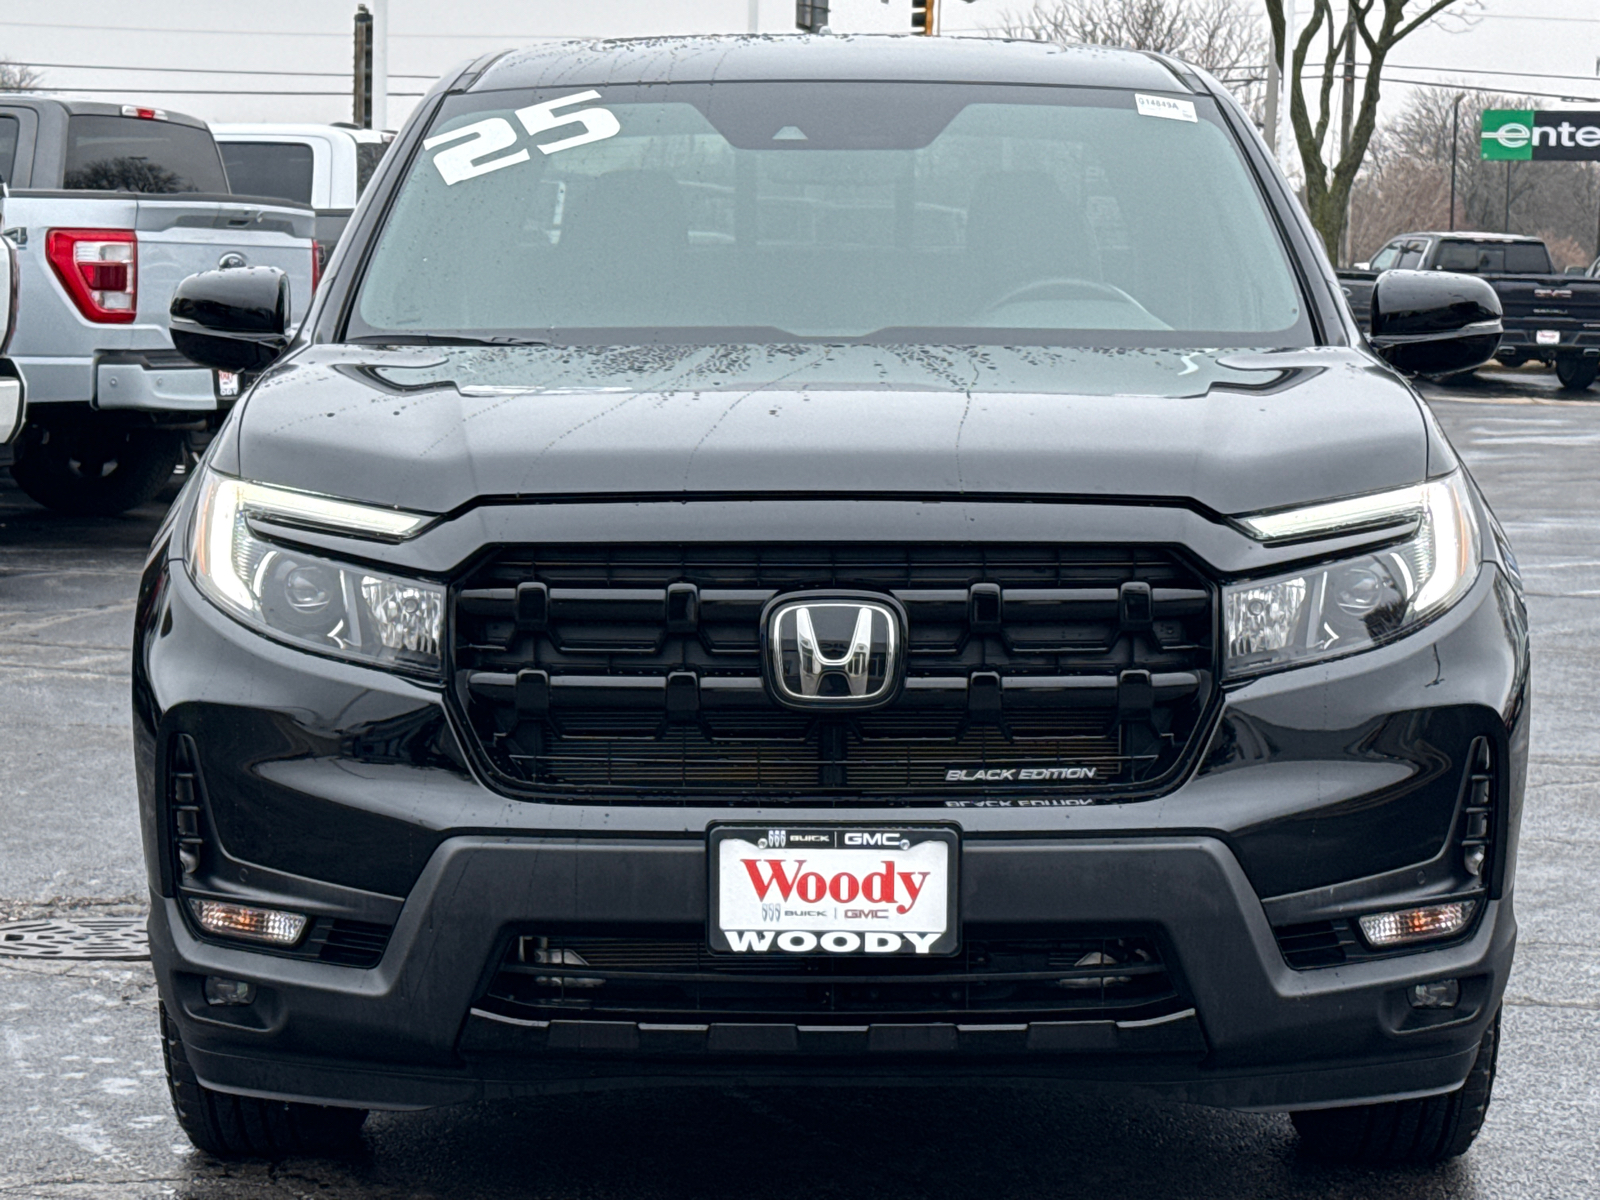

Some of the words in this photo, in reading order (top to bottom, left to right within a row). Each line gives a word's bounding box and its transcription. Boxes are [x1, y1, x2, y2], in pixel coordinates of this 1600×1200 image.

[423, 90, 620, 185] 25
[1481, 121, 1600, 148] ente
[945, 769, 1016, 781] BLACK
[1018, 767, 1097, 780] EDITION
[789, 834, 830, 842] BUICK
[844, 833, 900, 845] GMC
[740, 858, 931, 915] Woody
[844, 909, 889, 919] GMC
[723, 931, 942, 954] WOODY
